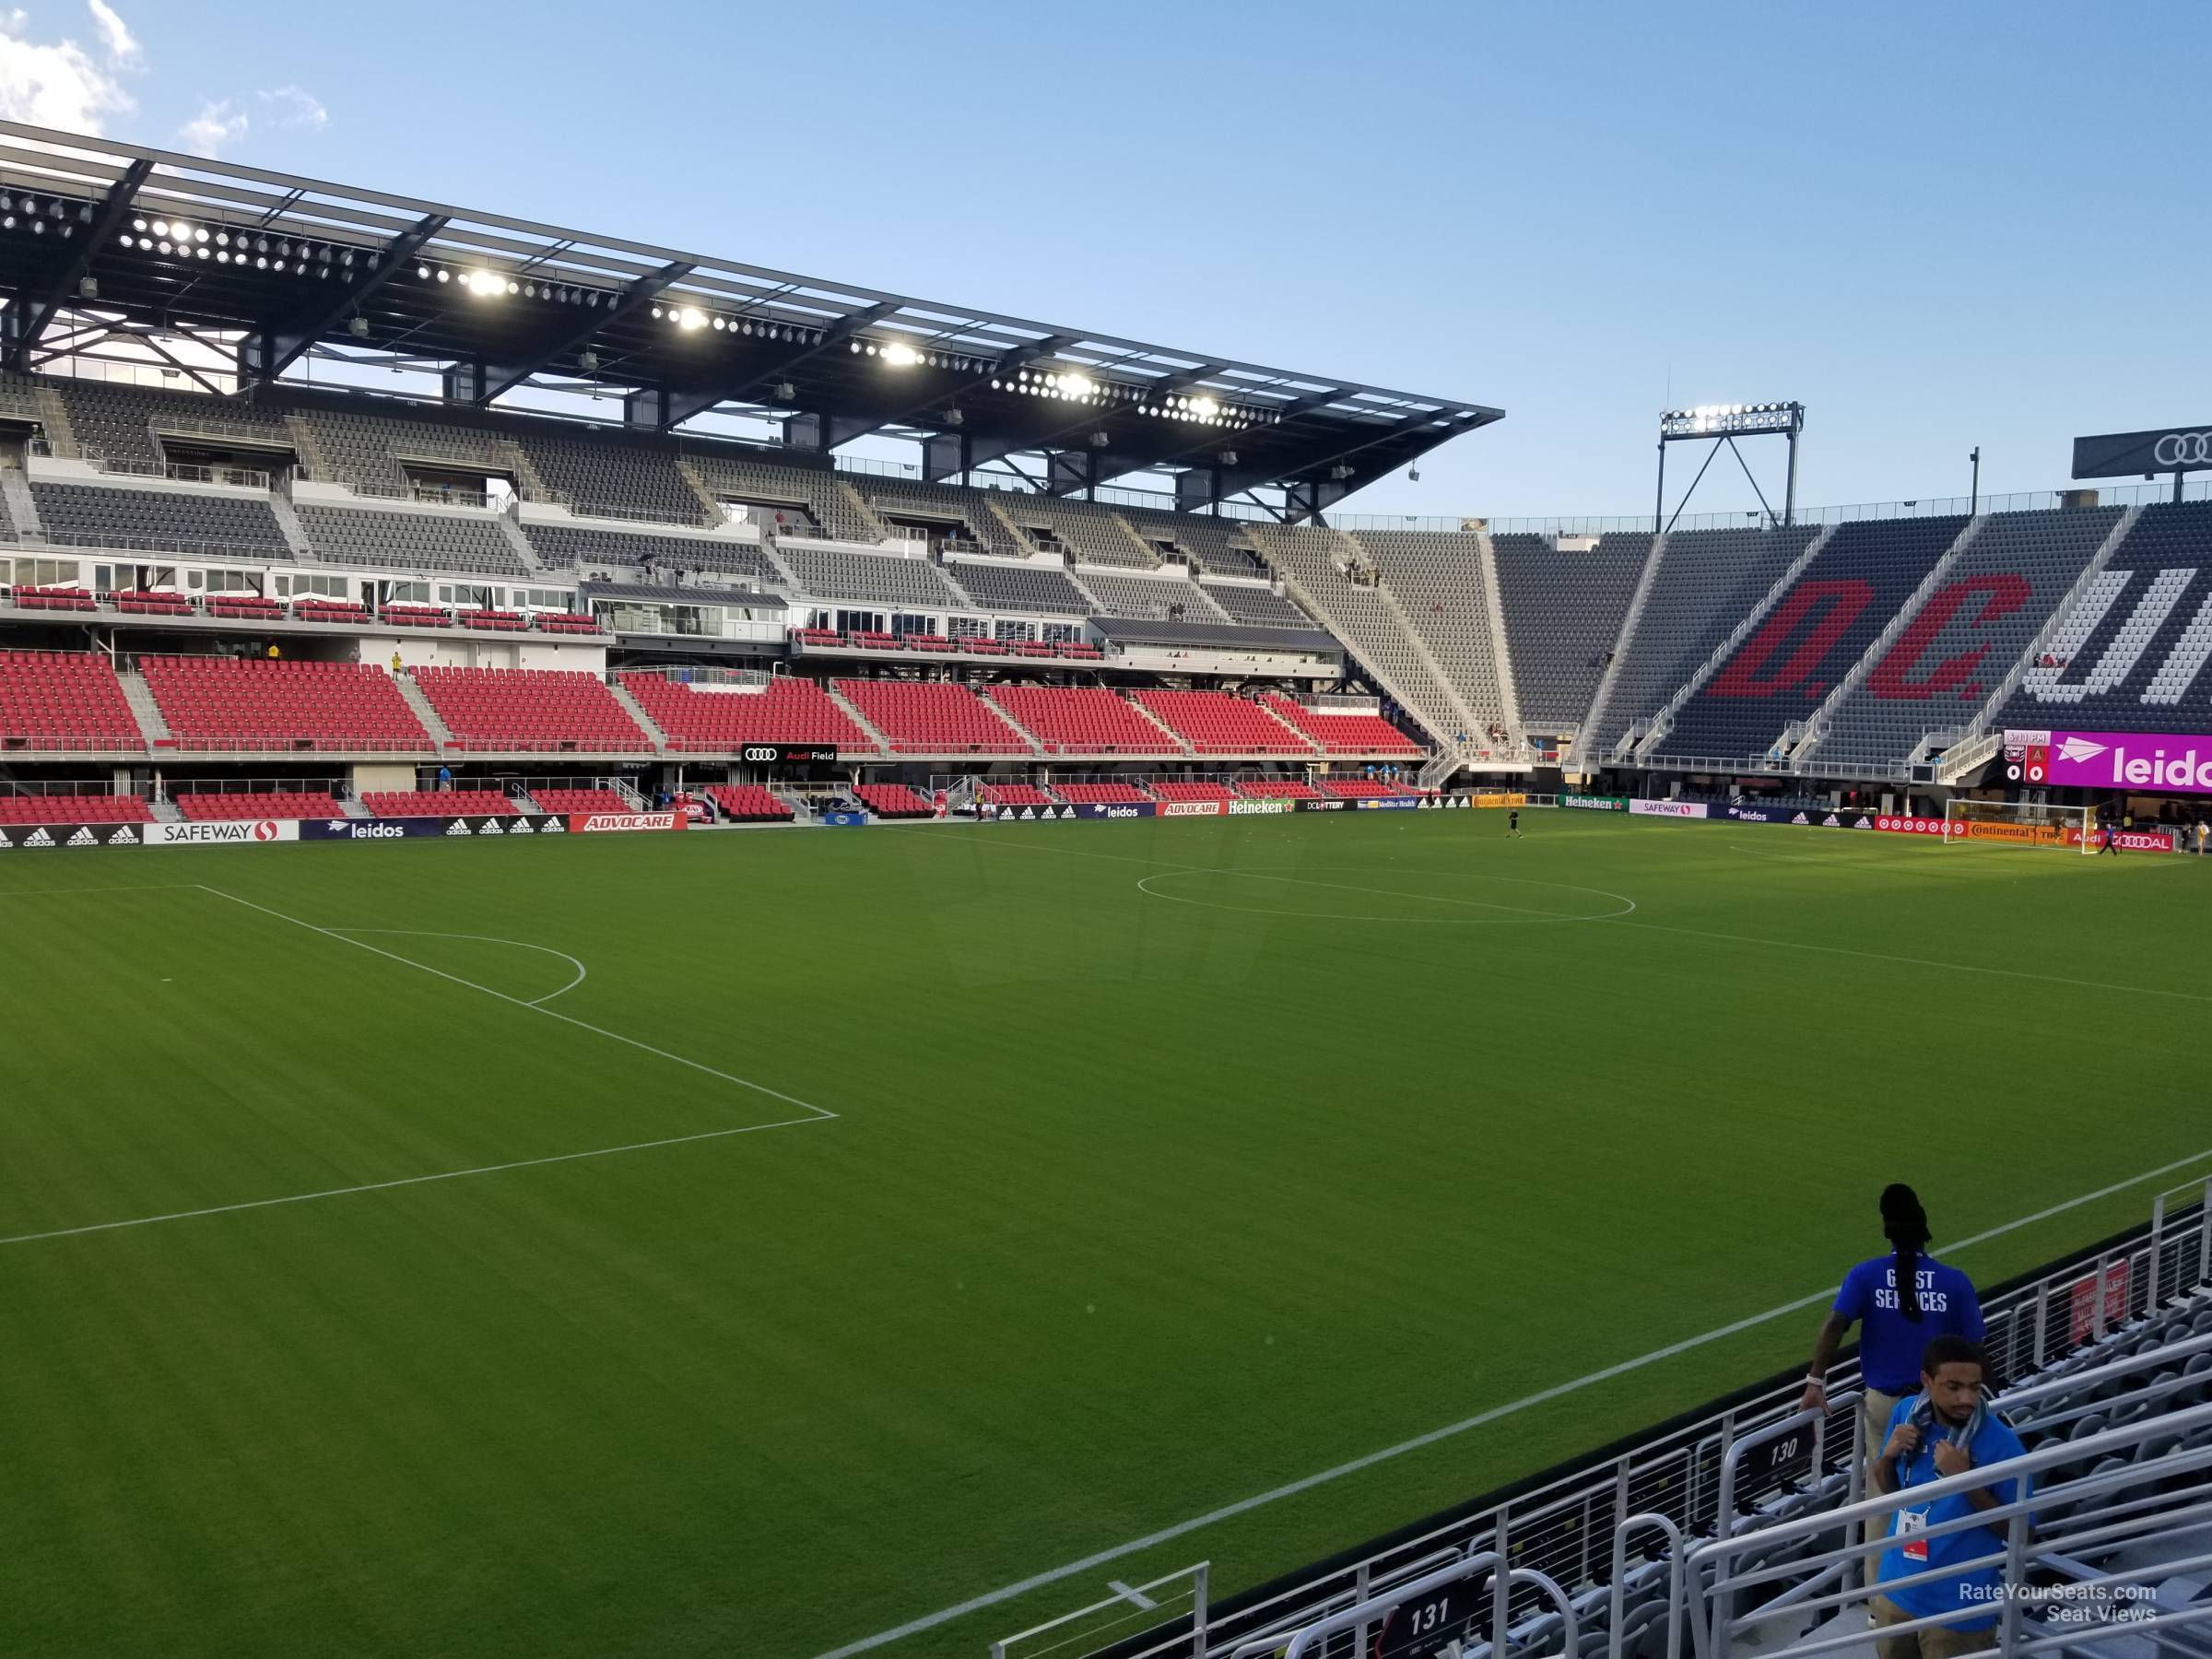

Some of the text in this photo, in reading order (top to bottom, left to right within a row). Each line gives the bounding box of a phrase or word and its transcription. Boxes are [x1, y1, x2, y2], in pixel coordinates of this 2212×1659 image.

[785, 751, 834, 760] Audi Field
[2006, 765, 2020, 781] 0
[2030, 766, 2043, 781] 0
[1164, 802, 1220, 816] ADVOCARE
[1229, 801, 1282, 815] Heineken
[1565, 795, 1612, 810] Heineken
[1643, 803, 1680, 814] SAFEWAY
[1107, 806, 1138, 818] leidos
[1739, 810, 1767, 821] leidos
[583, 814, 675, 830] ADVOCARE
[164, 824, 252, 841] SAFEWAY
[351, 822, 405, 839] leidos
[1971, 823, 2029, 837] Continental
[2073, 832, 2100, 842] Audi
[23, 839, 56, 847] adidas
[67, 837, 99, 846] adidas
[108, 836, 139, 844] adidas
[1886, 1269, 1936, 1289] GST
[1771, 1437, 1798, 1466] 130
[1412, 1597, 1449, 1636] 131
